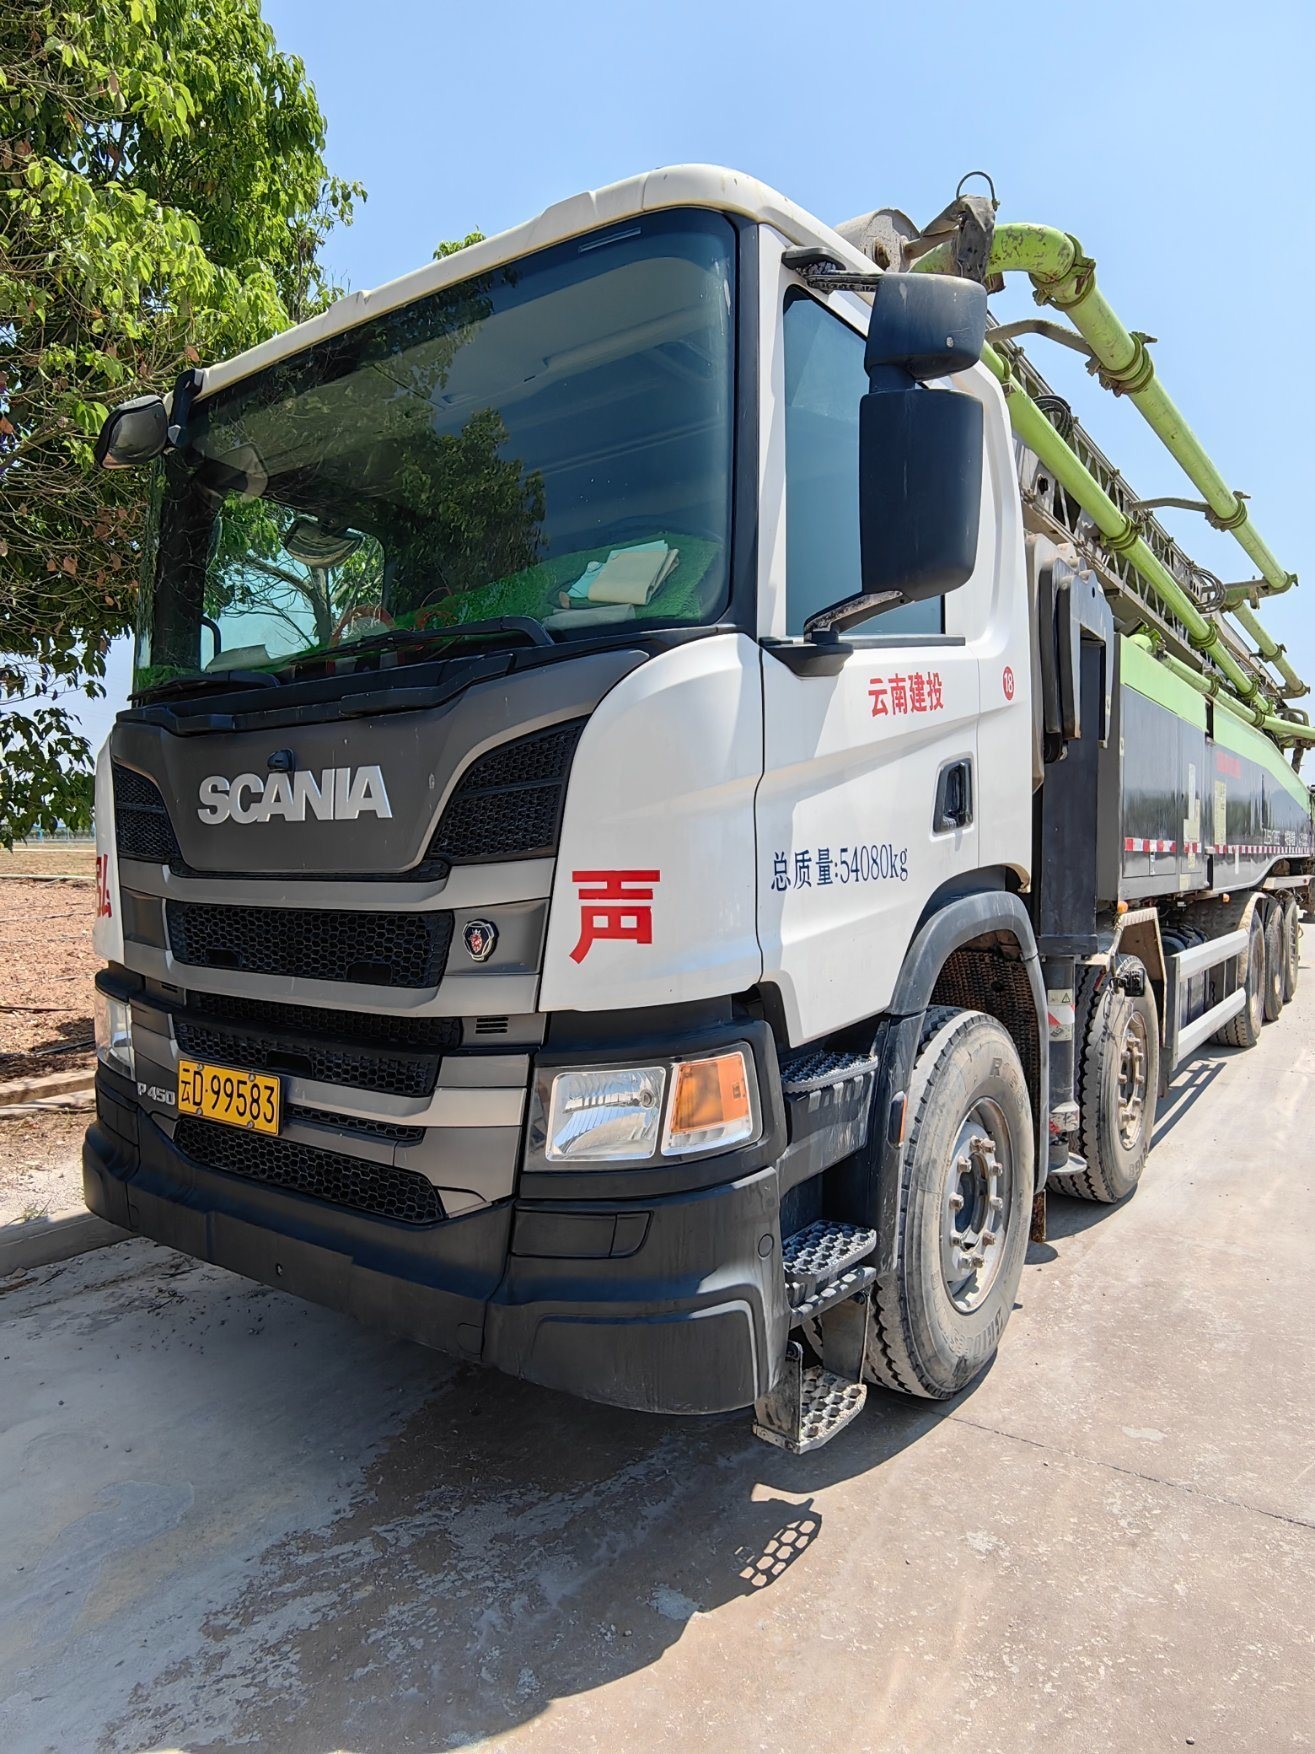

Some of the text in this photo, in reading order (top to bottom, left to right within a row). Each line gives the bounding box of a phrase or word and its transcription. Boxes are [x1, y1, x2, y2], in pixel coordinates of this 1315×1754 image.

[868, 671, 944, 717] 云南建投
[1003, 672, 1014, 694] 18
[197, 765, 393, 824] SCANIA
[771, 844, 908, 892] 总质量:54080kg
[569, 869, 661, 964] 声
